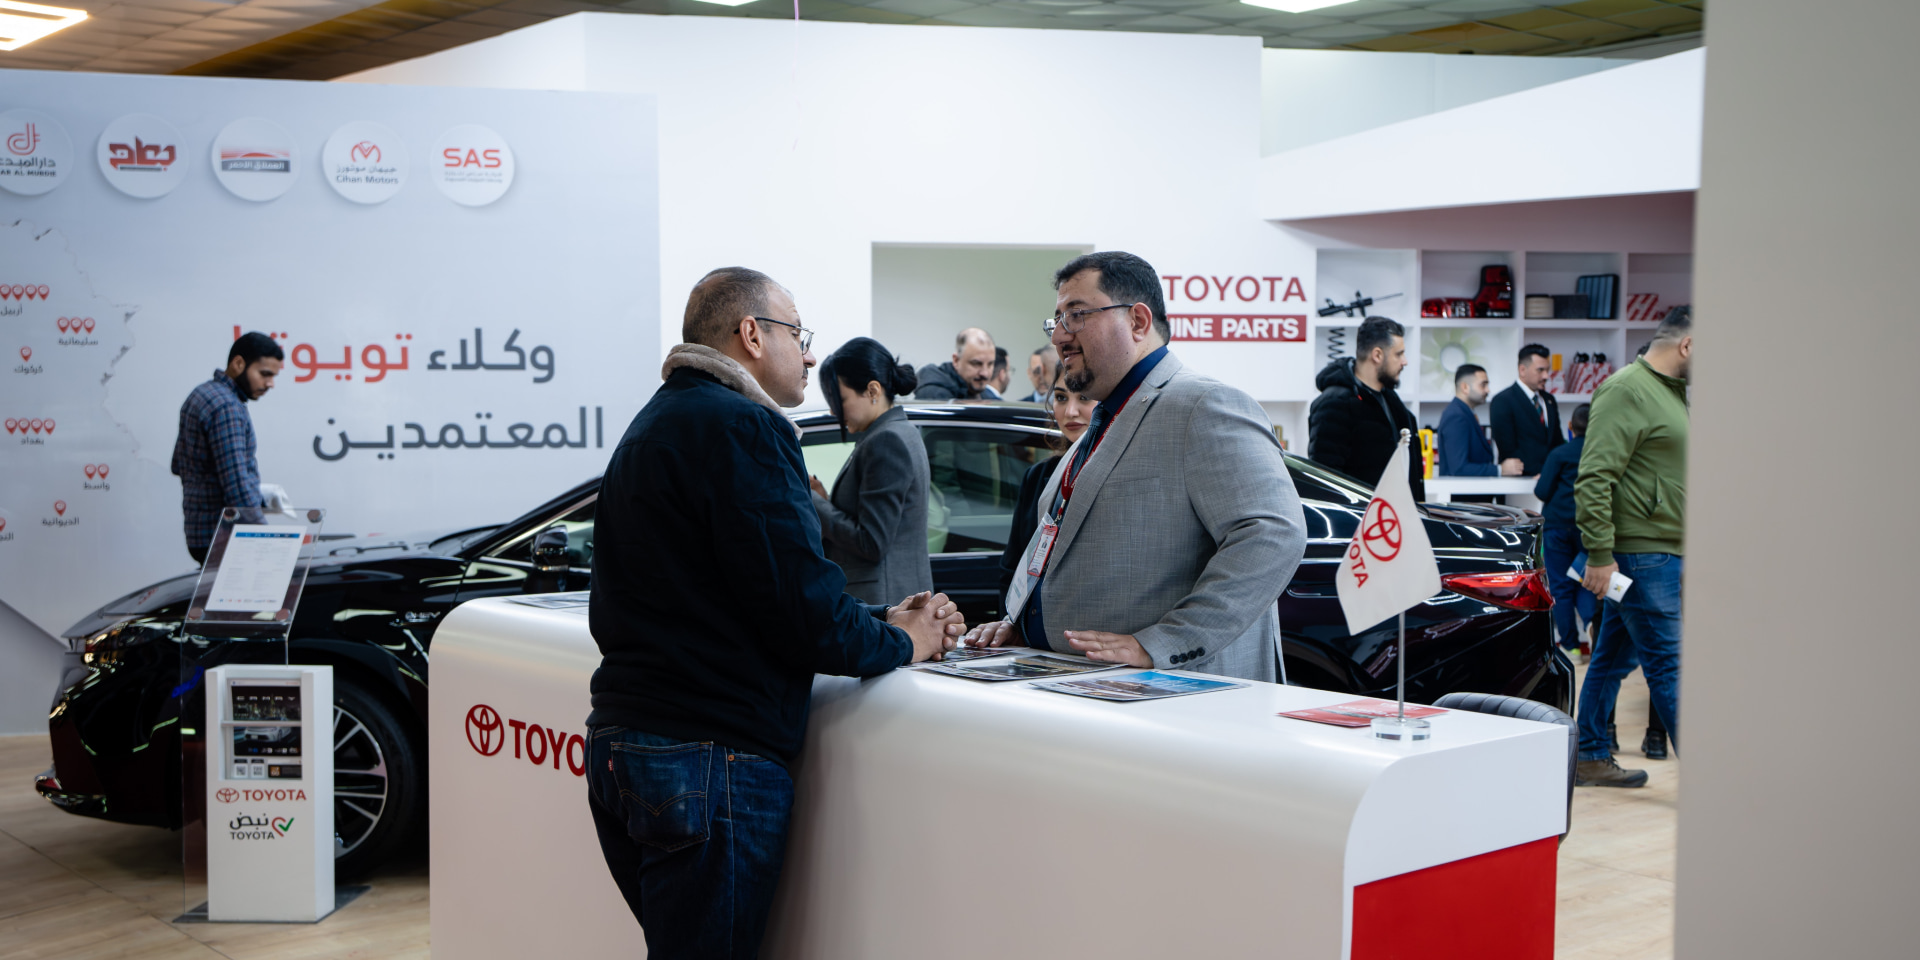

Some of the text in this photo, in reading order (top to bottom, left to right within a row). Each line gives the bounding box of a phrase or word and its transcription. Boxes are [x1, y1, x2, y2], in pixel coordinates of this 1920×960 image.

[443, 148, 502, 168] SAS
[336, 175, 399, 184] Cihan Motors
[1162, 275, 1307, 302] TOYOTA
[1221, 317, 1300, 339] PARTS
[233, 325, 556, 383] وكلاء تويو
[312, 406, 604, 461] المعتمدين
[508, 718, 586, 777] TOYO
[242, 788, 307, 802] TOYOTA
[229, 811, 269, 830] نبض
[230, 830, 275, 841] TOYOTA
